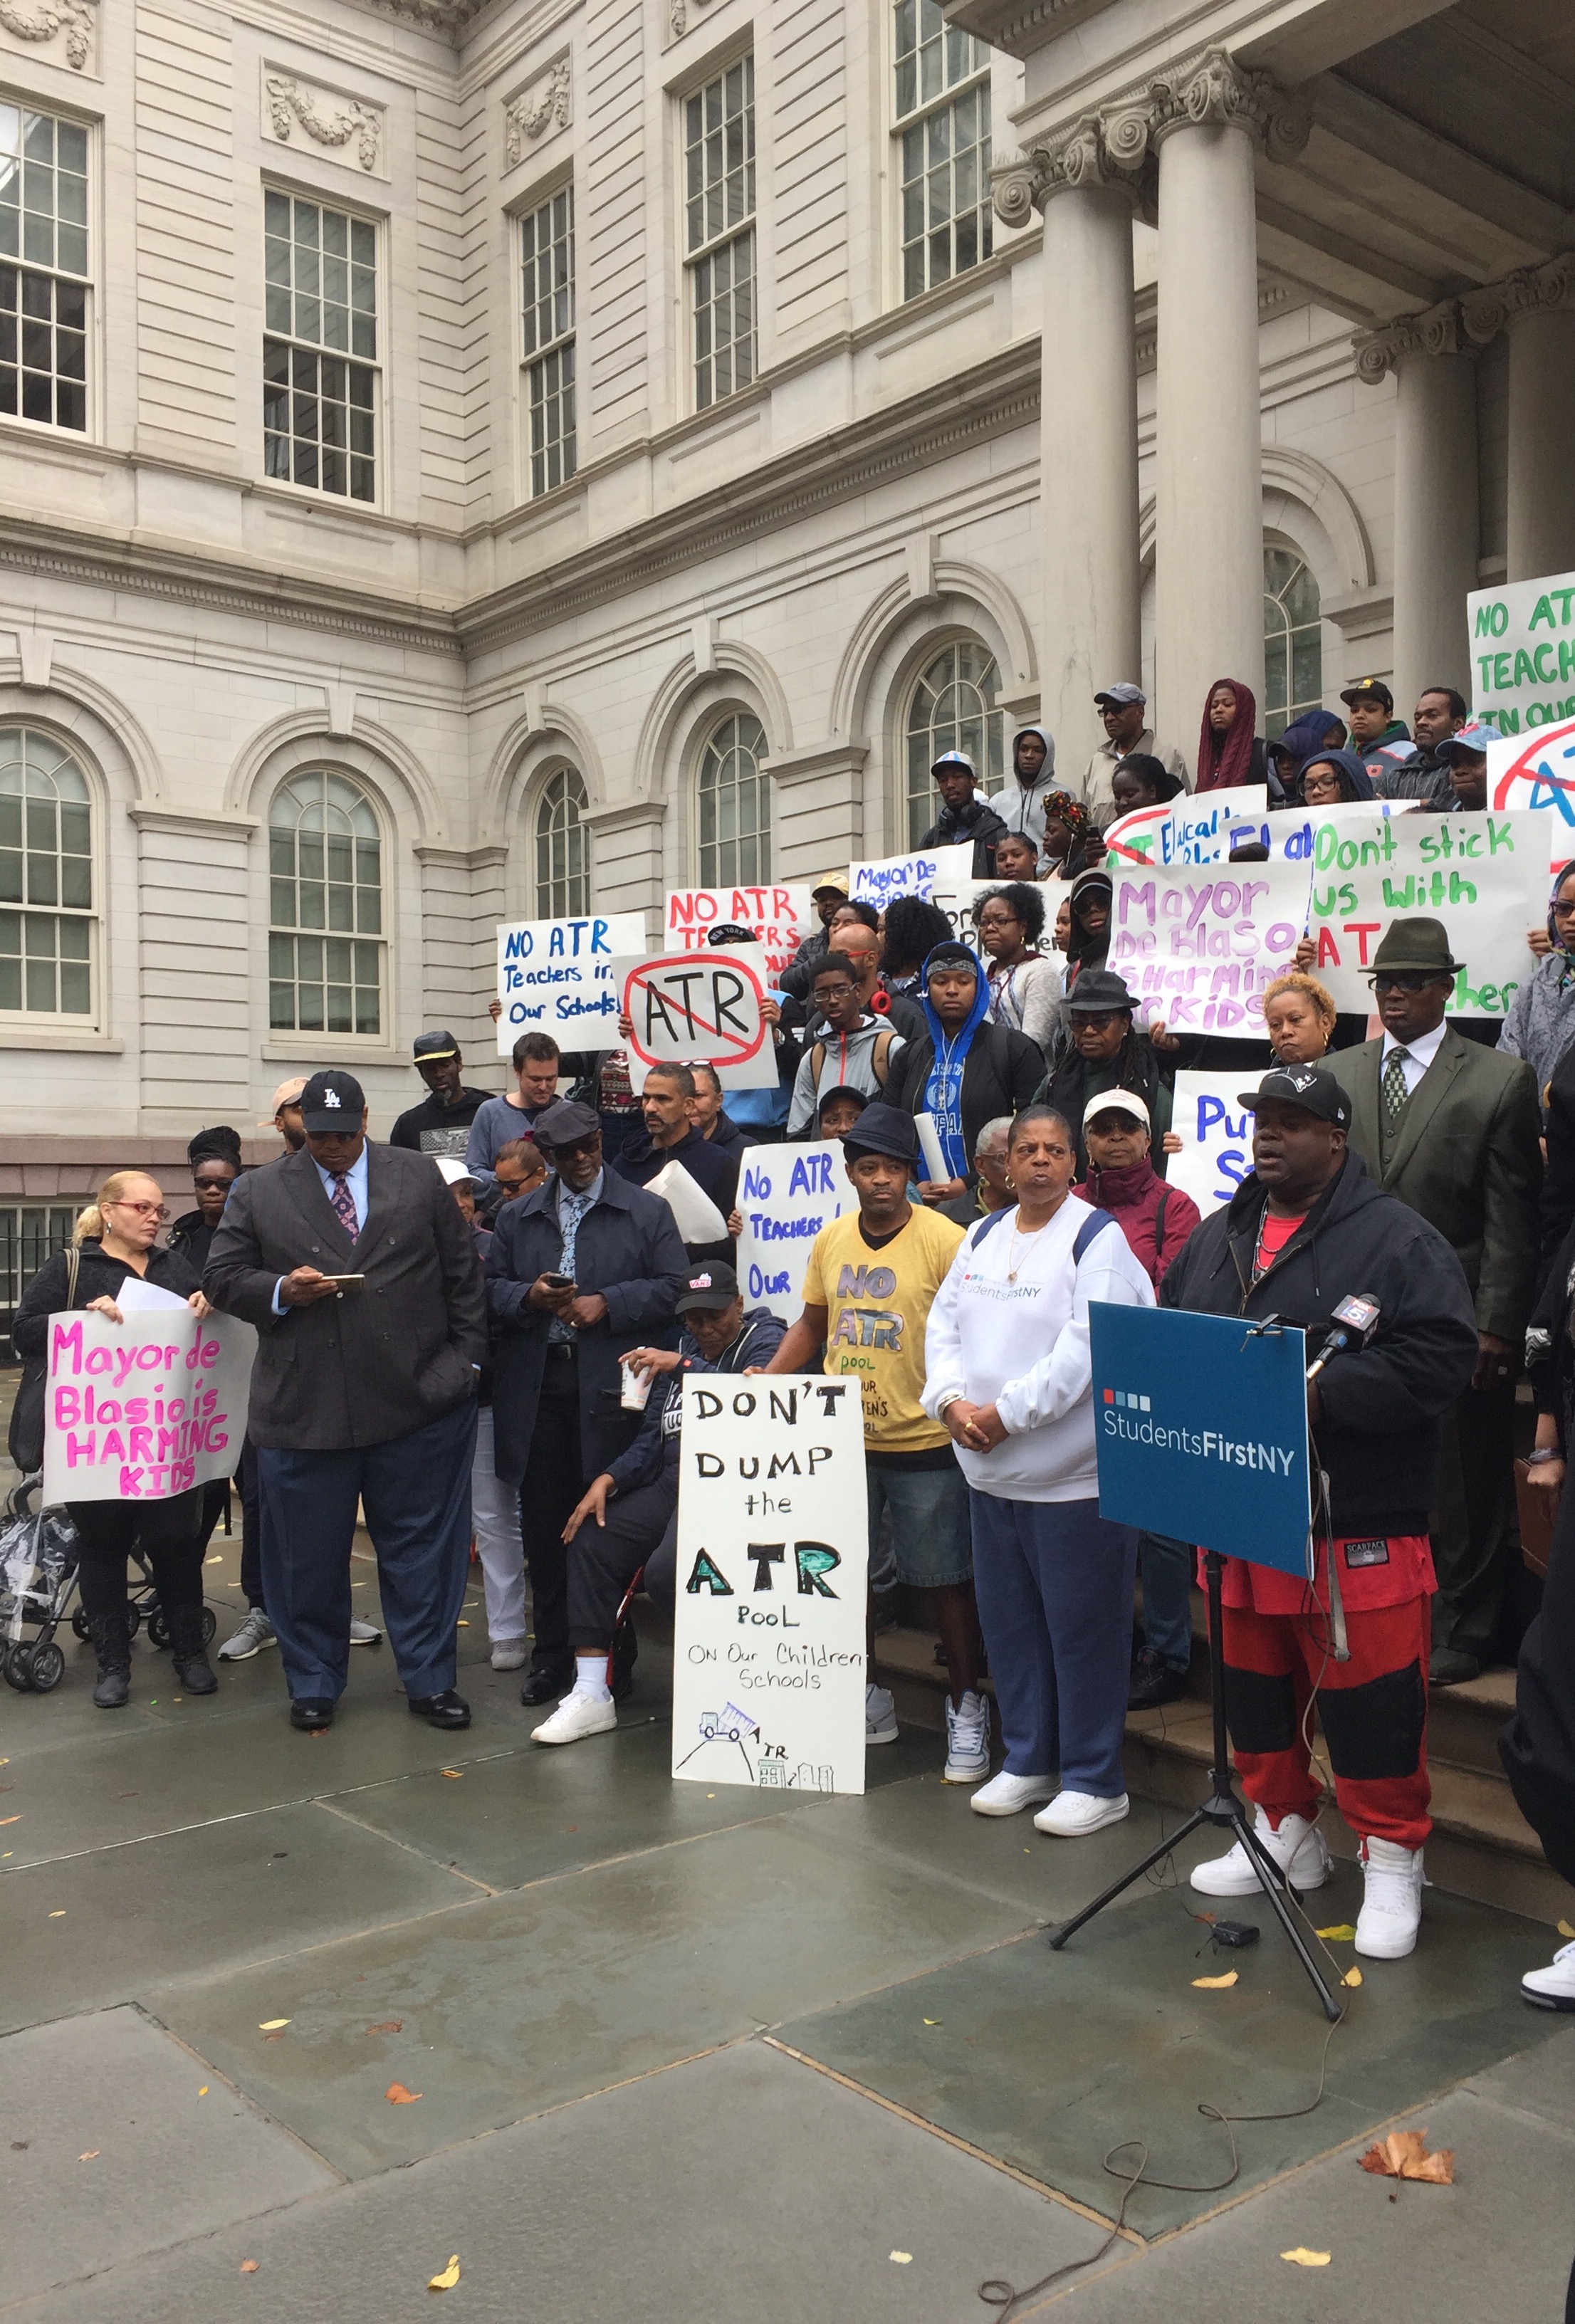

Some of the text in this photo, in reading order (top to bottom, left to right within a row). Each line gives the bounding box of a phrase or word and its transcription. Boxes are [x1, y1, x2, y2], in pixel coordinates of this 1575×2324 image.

[1475, 602, 1509, 638] NO
[1315, 815, 1514, 872] Don't stick
[857, 859, 937, 891] Mayor De
[669, 888, 798, 928] NO ATR
[1119, 881, 1270, 930] Mayor
[505, 919, 612, 959] NO ATR
[711, 927, 744, 942] NEW YORK
[503, 964, 582, 994] Teachers
[509, 1002, 547, 1024] Our
[647, 970, 750, 1047] ATR
[324, 1088, 342, 1108] LA
[789, 1153, 836, 1198] ATR
[837, 1264, 897, 1299] NO
[831, 1308, 904, 1351] ATR
[1347, 1307, 1365, 1320] 5
[52, 1320, 220, 1388] Mayor de
[55, 1378, 218, 1430] Blasio is
[692, 1381, 846, 1425] DON'T
[67, 1413, 229, 1468] HARMING
[1104, 1410, 1295, 1477] StudentsFirstNY
[120, 1456, 196, 1496] KIDS
[695, 1447, 833, 1480] DUMP
[745, 1491, 792, 1516] the
[1346, 1540, 1385, 1553] SCARFACE
[686, 1540, 842, 1601] ATR
[728, 1642, 758, 1663] Our
[739, 1669, 821, 1690] Schools
